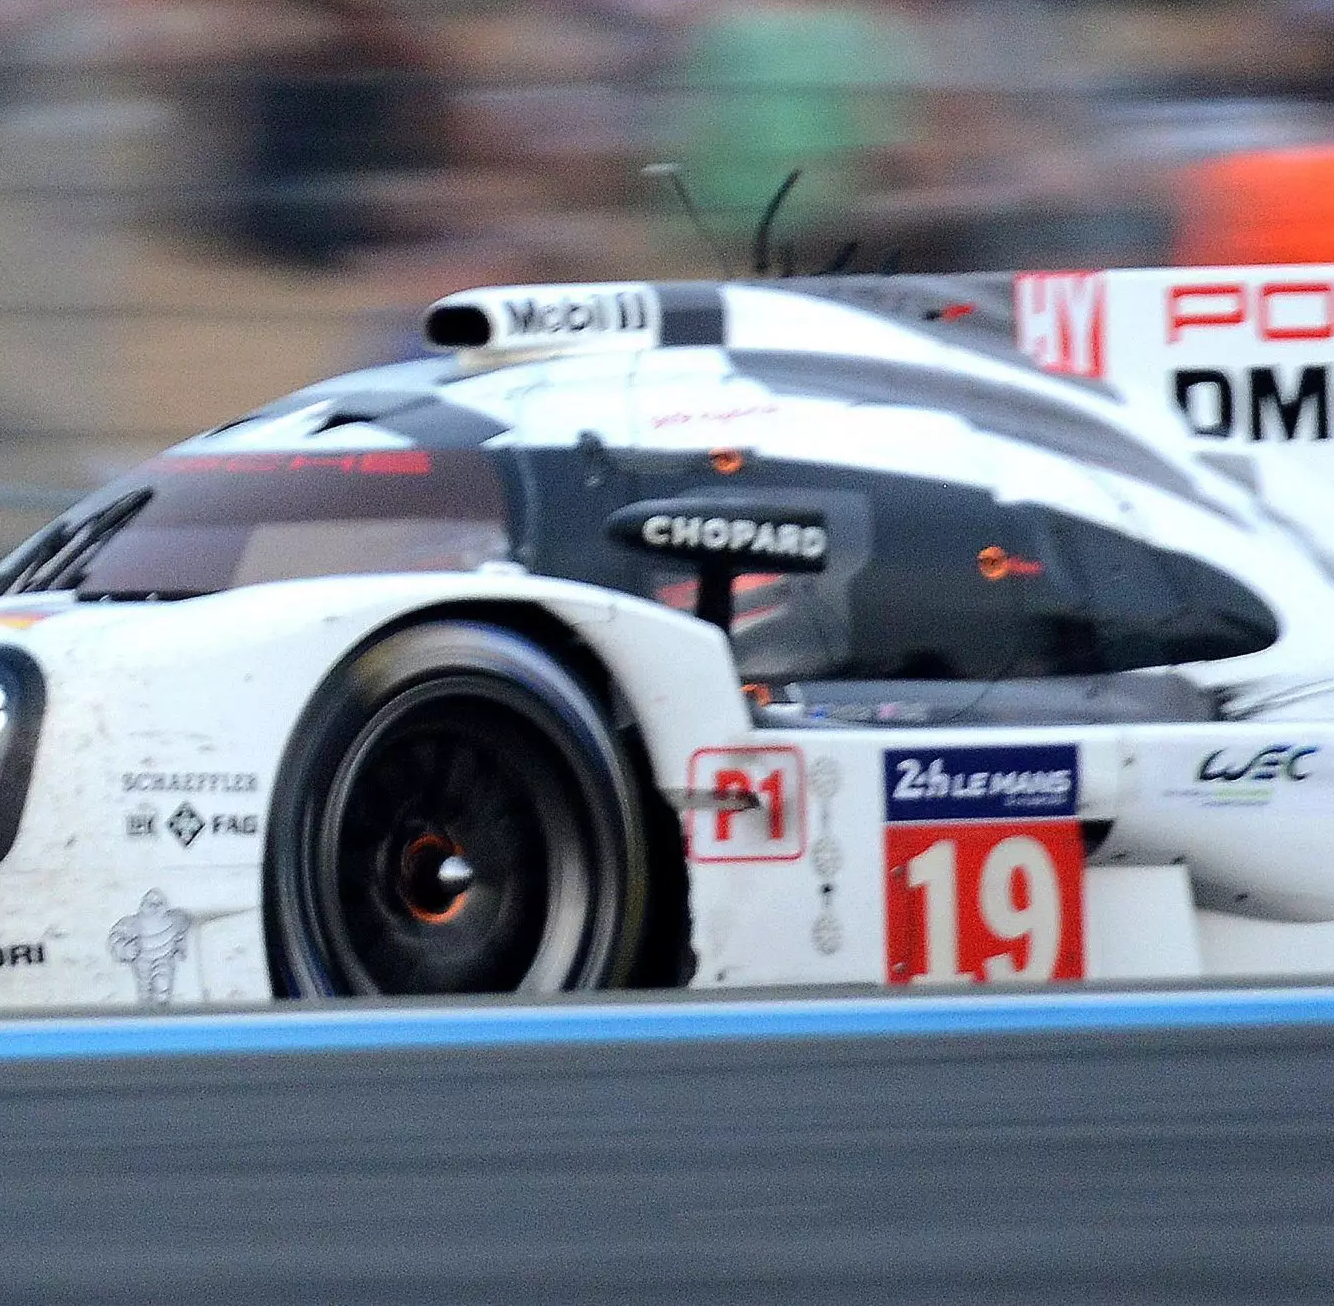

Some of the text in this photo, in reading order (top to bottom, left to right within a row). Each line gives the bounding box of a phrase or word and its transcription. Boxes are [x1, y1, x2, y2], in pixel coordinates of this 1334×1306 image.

[1019, 277, 1106, 371] HY
[642, 514, 828, 558] CHOPARD
[1196, 742, 1320, 782] WEC
[713, 767, 788, 842] P1
[952, 772, 990, 798] LE
[212, 814, 258, 835] FAG
[907, 834, 1061, 983] 19
